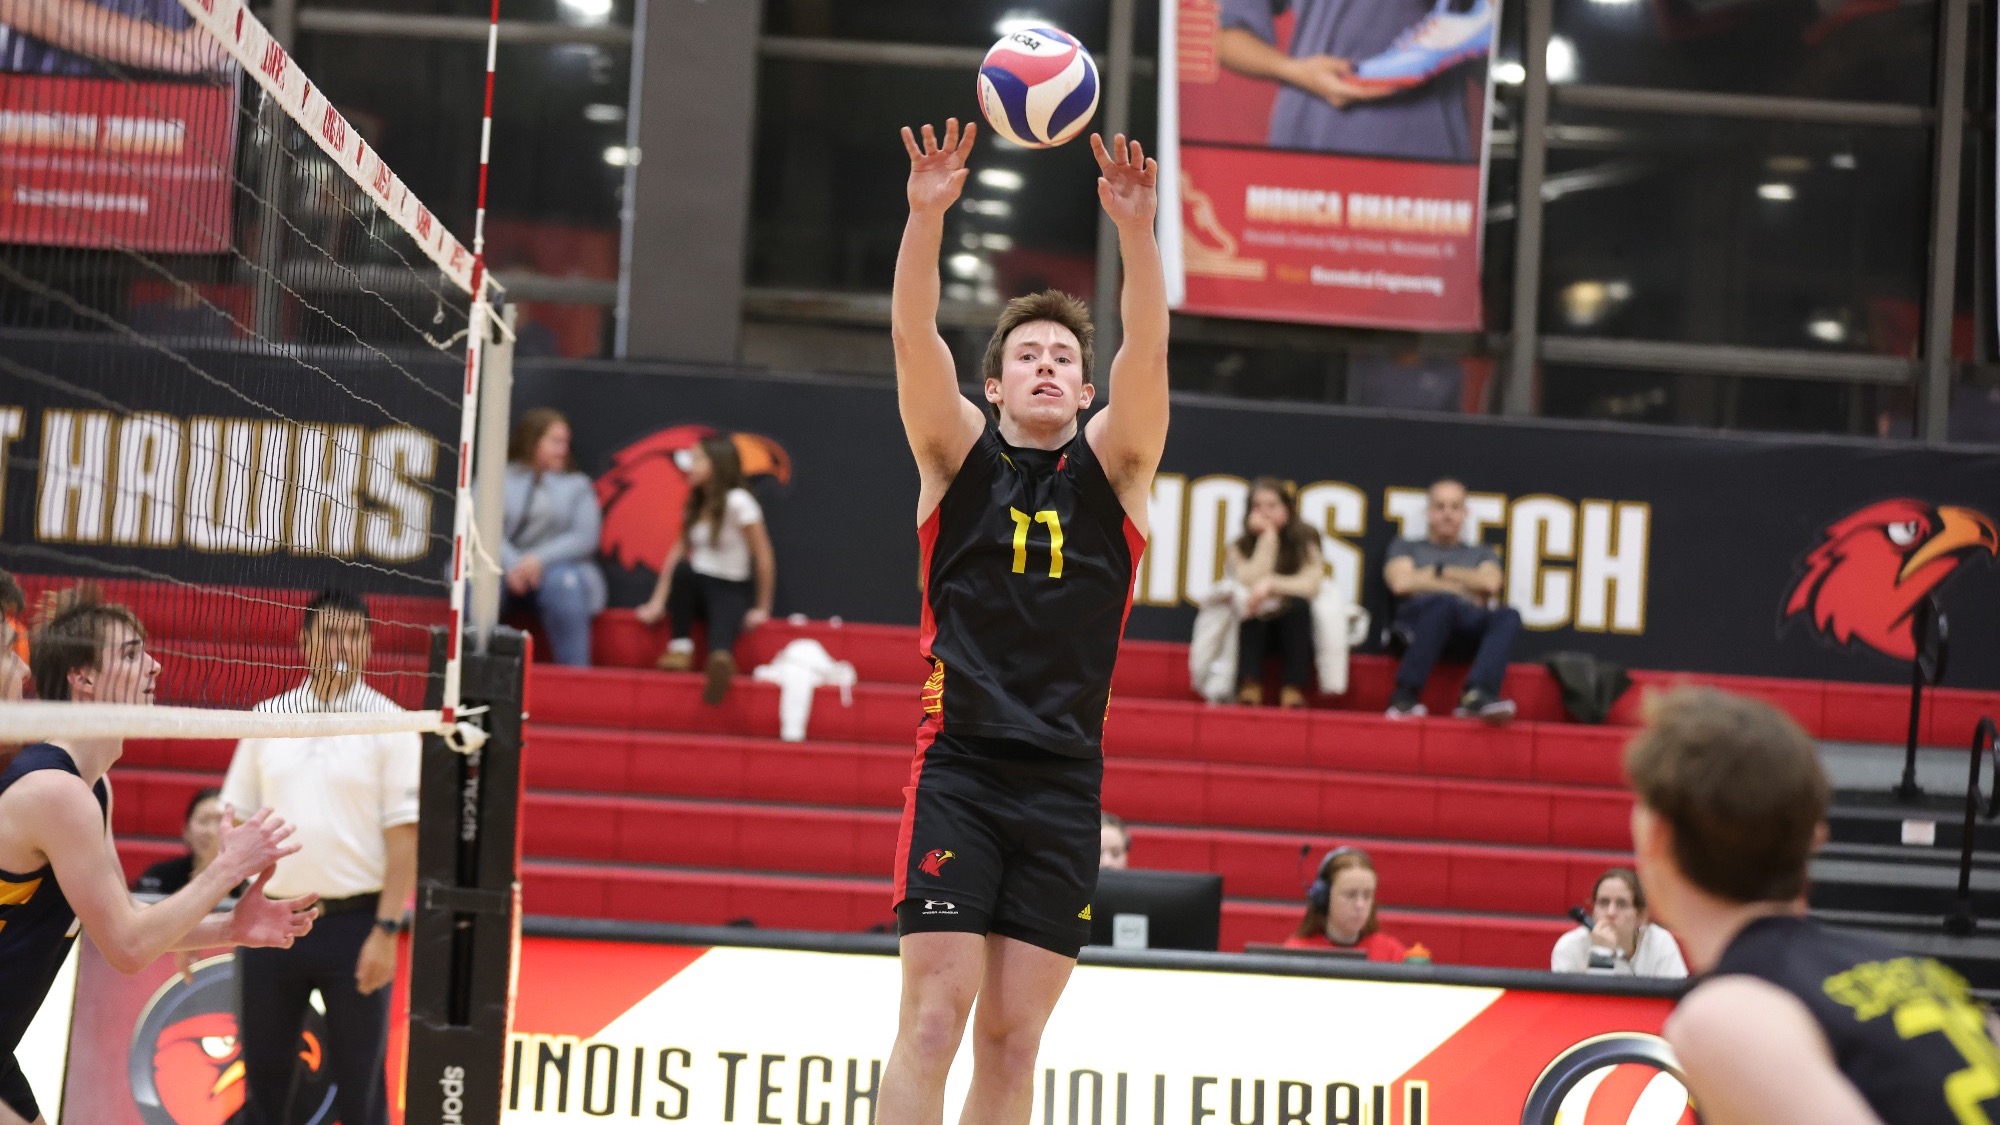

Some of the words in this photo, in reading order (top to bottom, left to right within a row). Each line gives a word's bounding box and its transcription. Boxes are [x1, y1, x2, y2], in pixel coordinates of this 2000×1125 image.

[36, 407, 438, 564] HAWKS
[438, 1065, 466, 1125] spor
[718, 1052, 882, 1125] TECH
